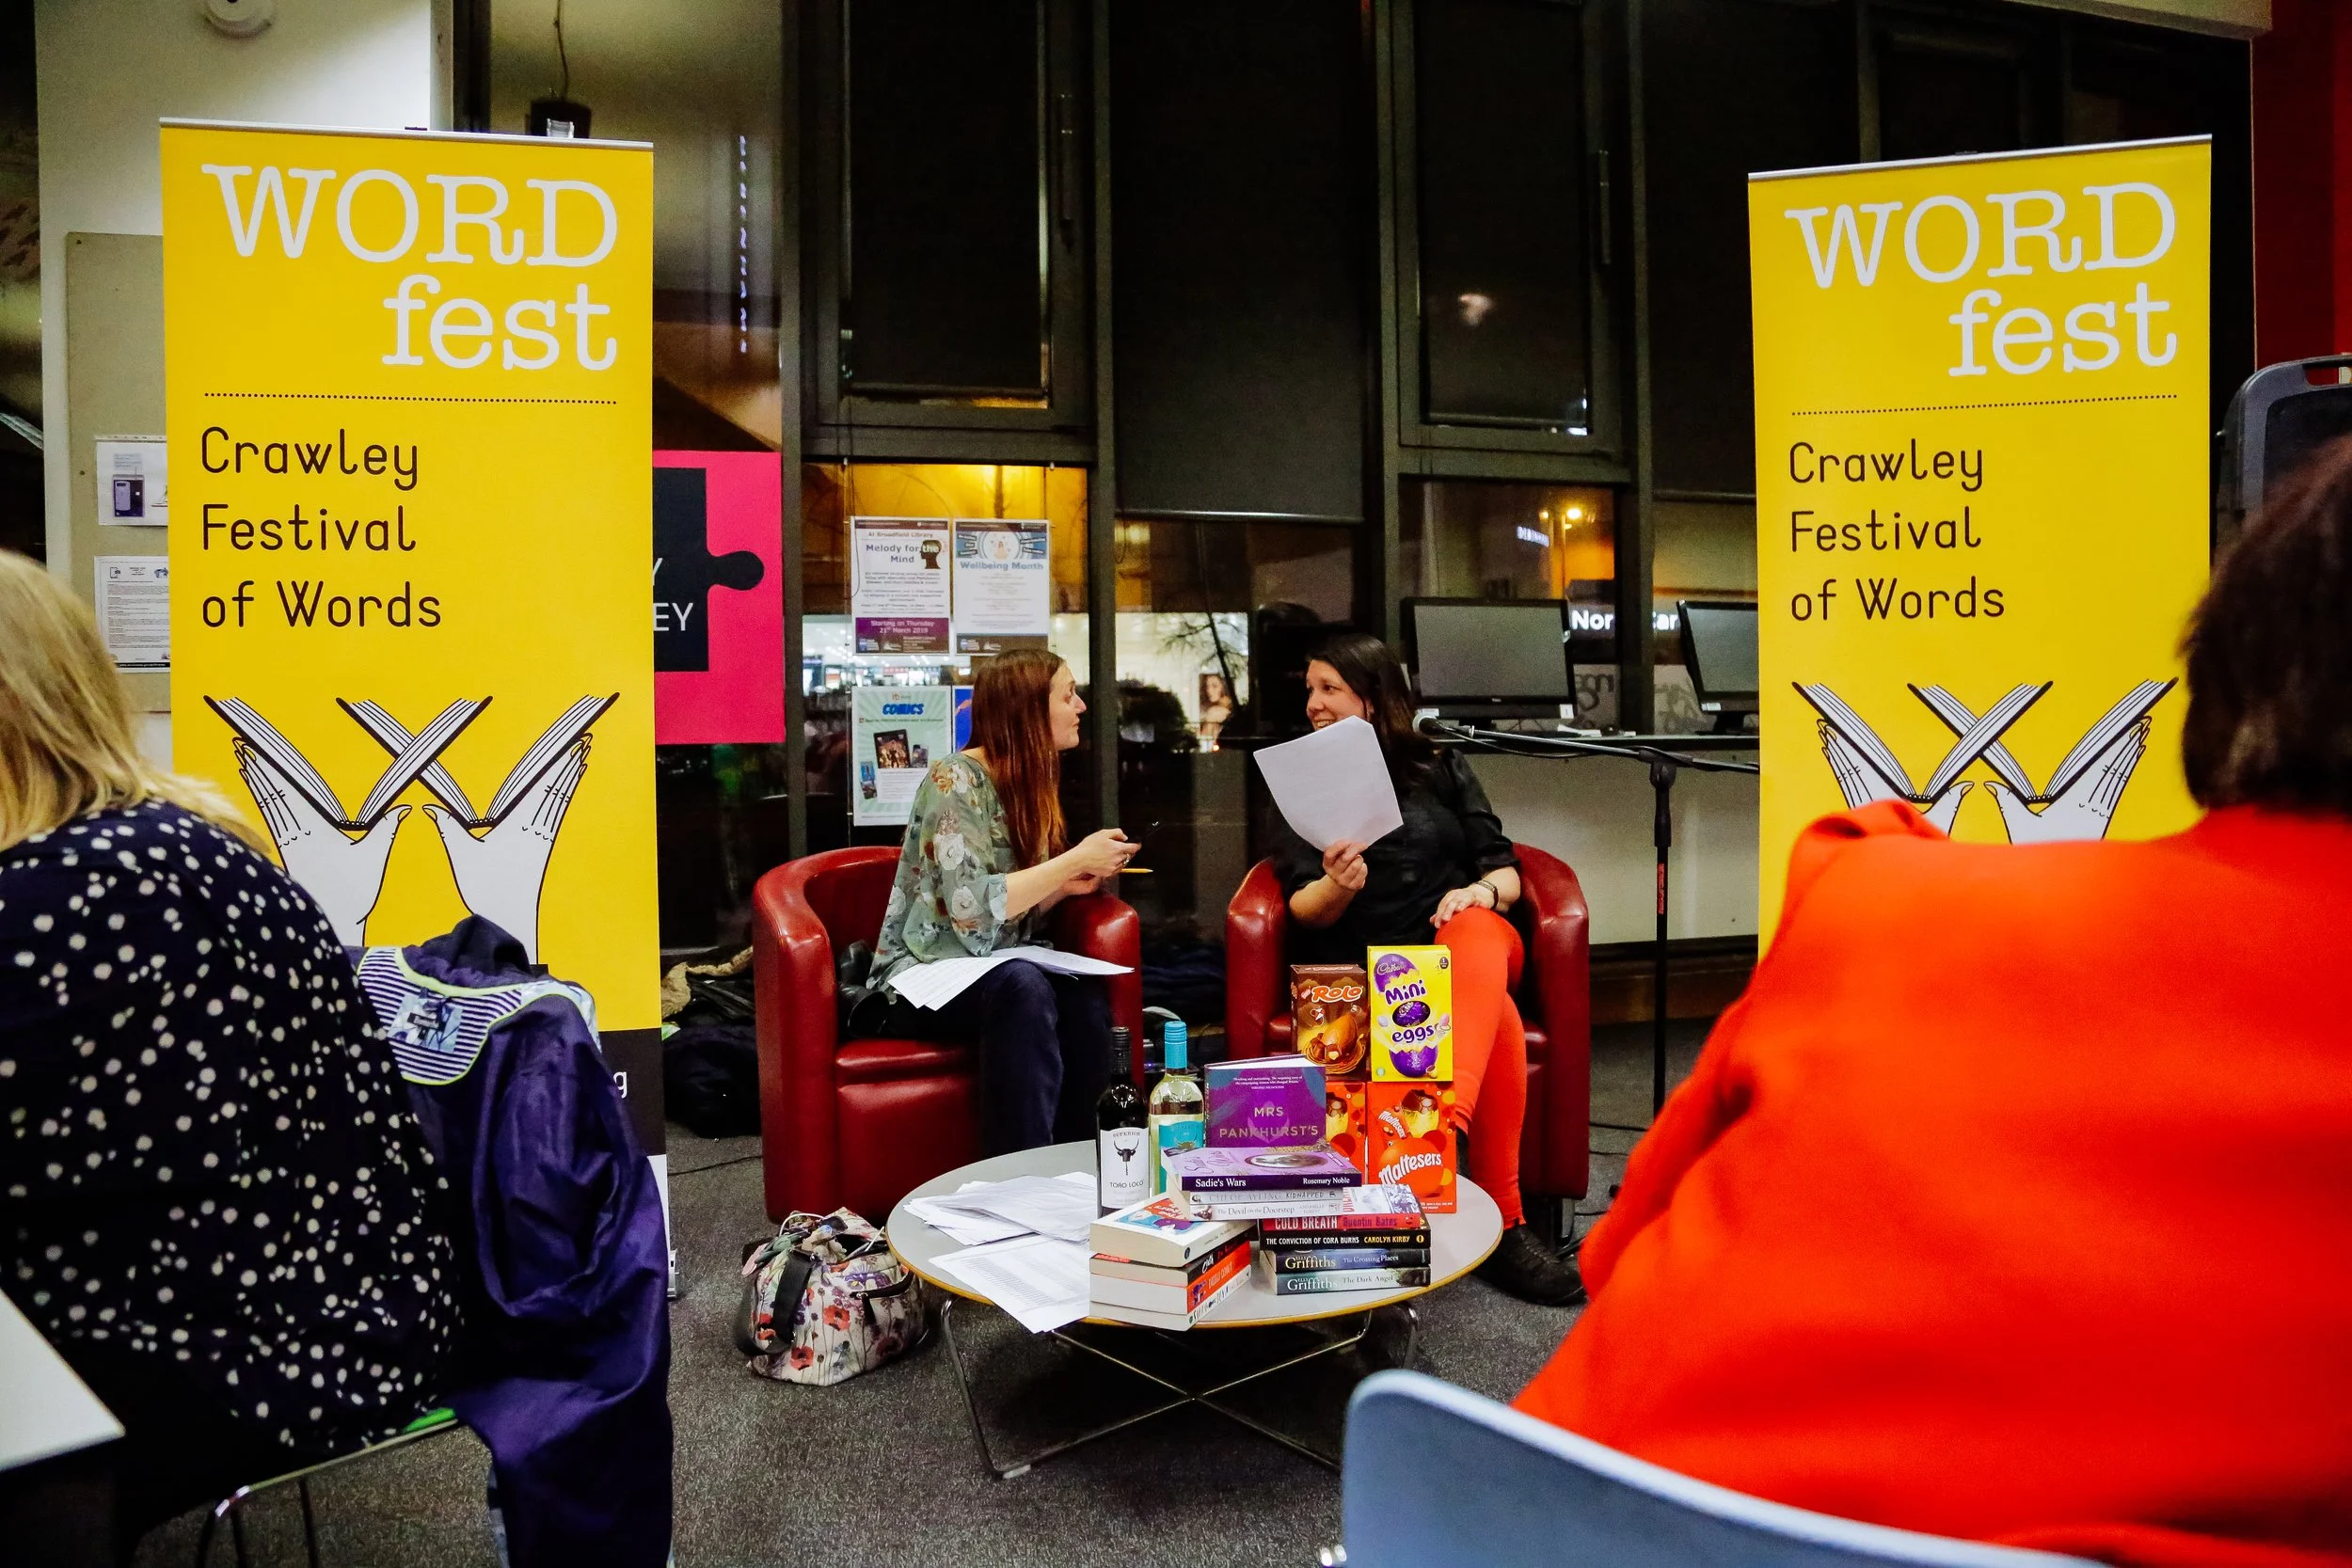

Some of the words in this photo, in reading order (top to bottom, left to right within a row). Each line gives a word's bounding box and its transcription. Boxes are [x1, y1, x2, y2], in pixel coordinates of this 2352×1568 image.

[201, 163, 617, 267] WORD
[1784, 182, 2176, 289] WORD
[382, 274, 617, 371] fest
[1948, 282, 2177, 376] fest
[201, 426, 418, 491] Crawley
[1789, 437, 1982, 492] Crawley
[202, 503, 417, 551] Festival
[1791, 505, 1981, 552] Festival
[866, 544, 902, 553] Melody
[905, 544, 920, 552] for
[890, 555, 914, 563] Mind
[960, 561, 1009, 571] Wellbeing
[1011, 562, 1043, 570] Month
[202, 580, 255, 627] of
[276, 580, 441, 627] Words
[1791, 578, 1837, 621] of
[1855, 575, 2004, 620] Words
[1311, 986, 1364, 1003] Rolo
[1385, 979, 1426, 1006] Mini
[1391, 1024, 1435, 1044] eggs
[1254, 1106, 1284, 1117] MRS
[1219, 1125, 1318, 1138] PANKHURST'S
[1378, 1152, 1442, 1186] Maltesers
[1195, 1178, 1224, 1187] Sadie's
[1225, 1178, 1247, 1187] Wars
[1302, 1177, 1332, 1185] Rosemary
[1332, 1177, 1350, 1185] Noble
[1263, 1206, 1295, 1214] Doorstep
[1301, 1215, 1338, 1229] BREATH
[1343, 1216, 1373, 1227] Quentin
[1375, 1215, 1398, 1227] Bates
[1279, 1237, 1312, 1245] CONVICTION
[1391, 1235, 1410, 1243] KIRBY
[1285, 1256, 1337, 1270] Griffiths
[1287, 1277, 1338, 1291] Griffiths
[1374, 1275, 1394, 1283] Angel
